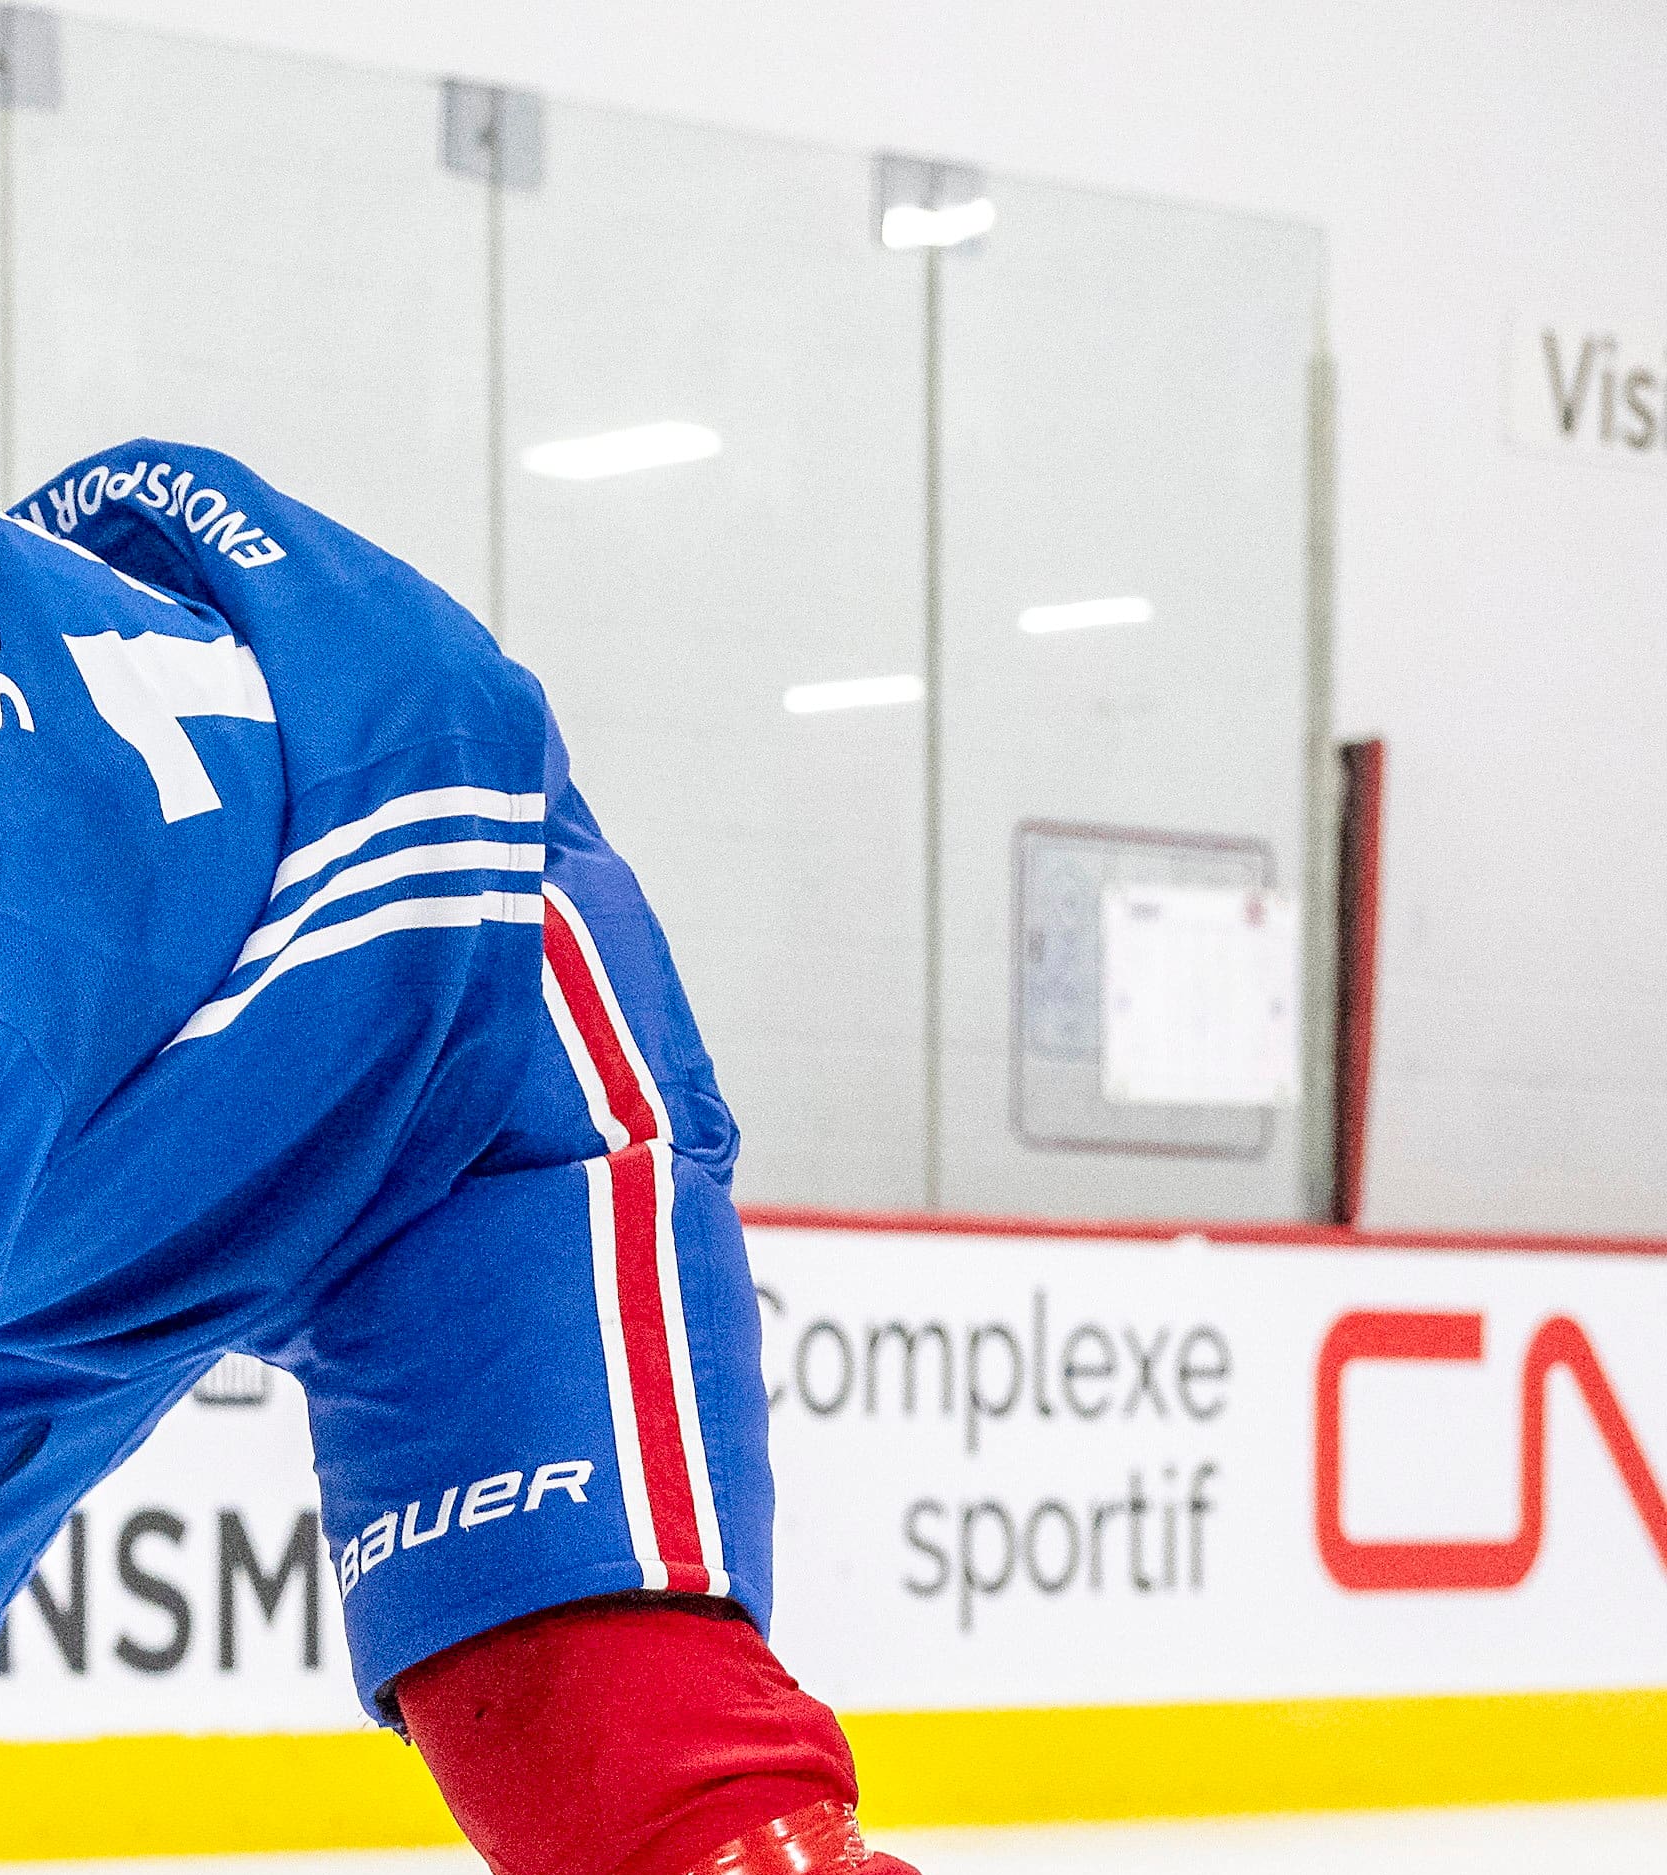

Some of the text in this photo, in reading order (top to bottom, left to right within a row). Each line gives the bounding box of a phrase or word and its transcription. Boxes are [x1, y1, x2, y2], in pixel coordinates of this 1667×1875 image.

[1539, 328, 1667, 452] Vis
[340, 1458, 595, 1601] BAUER
[903, 1462, 1220, 1632] sportif
